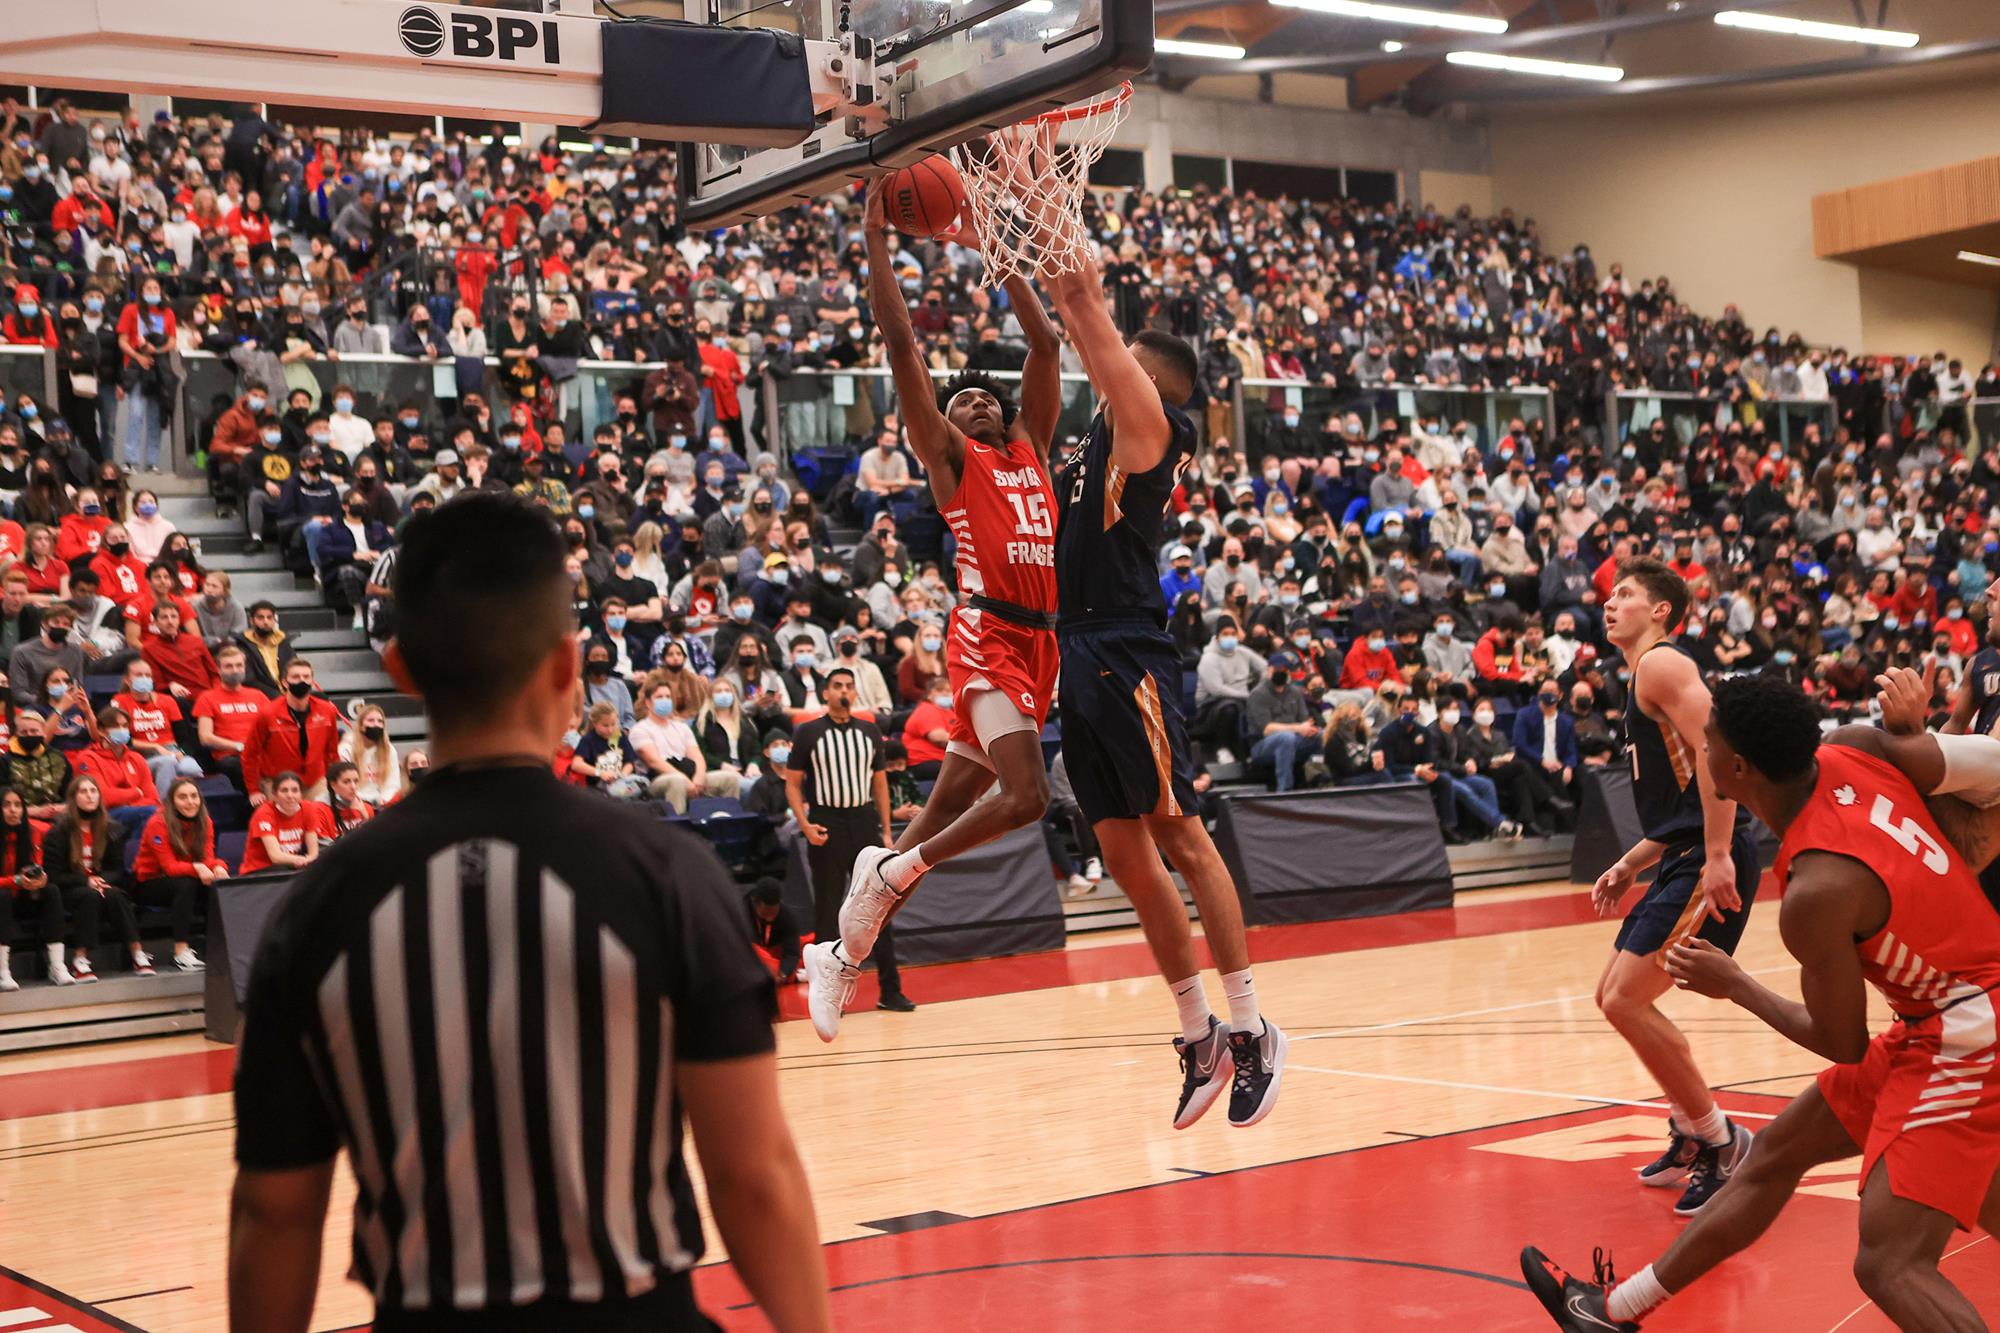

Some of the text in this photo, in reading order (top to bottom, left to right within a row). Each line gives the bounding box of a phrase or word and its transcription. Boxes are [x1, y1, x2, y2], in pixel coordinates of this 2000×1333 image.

[451, 13, 560, 64] BPI
[1007, 493, 1053, 537] 15
[1006, 541, 1055, 568] FRASE
[1869, 793, 1949, 875] 5
